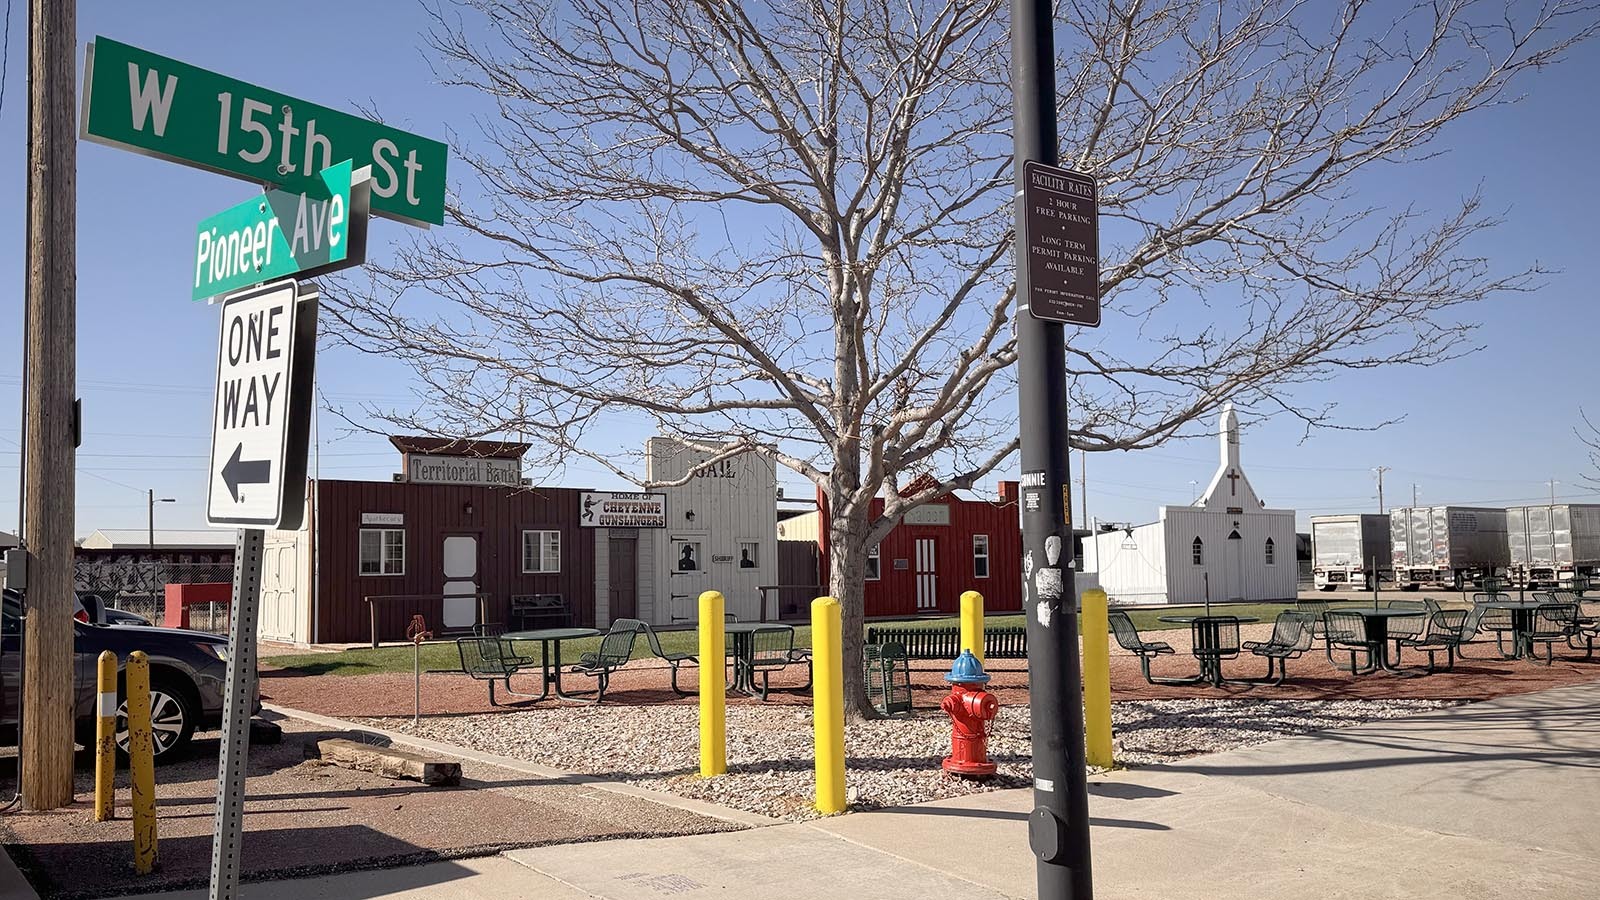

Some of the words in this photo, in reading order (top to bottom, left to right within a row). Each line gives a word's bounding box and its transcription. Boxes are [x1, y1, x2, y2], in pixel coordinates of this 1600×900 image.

[127, 61, 179, 137] W
[217, 91, 332, 178] 15th
[370, 138, 423, 206] St
[1032, 173, 1065, 191] FACILITY
[1068, 181, 1093, 197] RATES
[1049, 197, 1053, 206] 2
[1056, 199, 1077, 211] HOUR
[1036, 206, 1056, 218] FREE
[1058, 211, 1091, 225] PARKING
[194, 214, 279, 288] Pioneer
[290, 191, 344, 258] Ave
[1041, 235, 1062, 246] LONG
[1064, 240, 1086, 251] TERM
[1032, 246, 1060, 258] PERMIT
[1064, 252, 1096, 264] PARKING
[1045, 262, 1085, 275] AVAILABLE
[228, 305, 284, 367] ONE
[223, 371, 281, 430] WAY
[412, 458, 481, 482] Territorial
[486, 461, 516, 483] Bank
[695, 459, 737, 478] JAIL
[611, 492, 639, 500] HOME
[642, 493, 654, 501] OF
[603, 501, 661, 514] CHEYENNE
[599, 514, 664, 526] GUNSLINGERS
